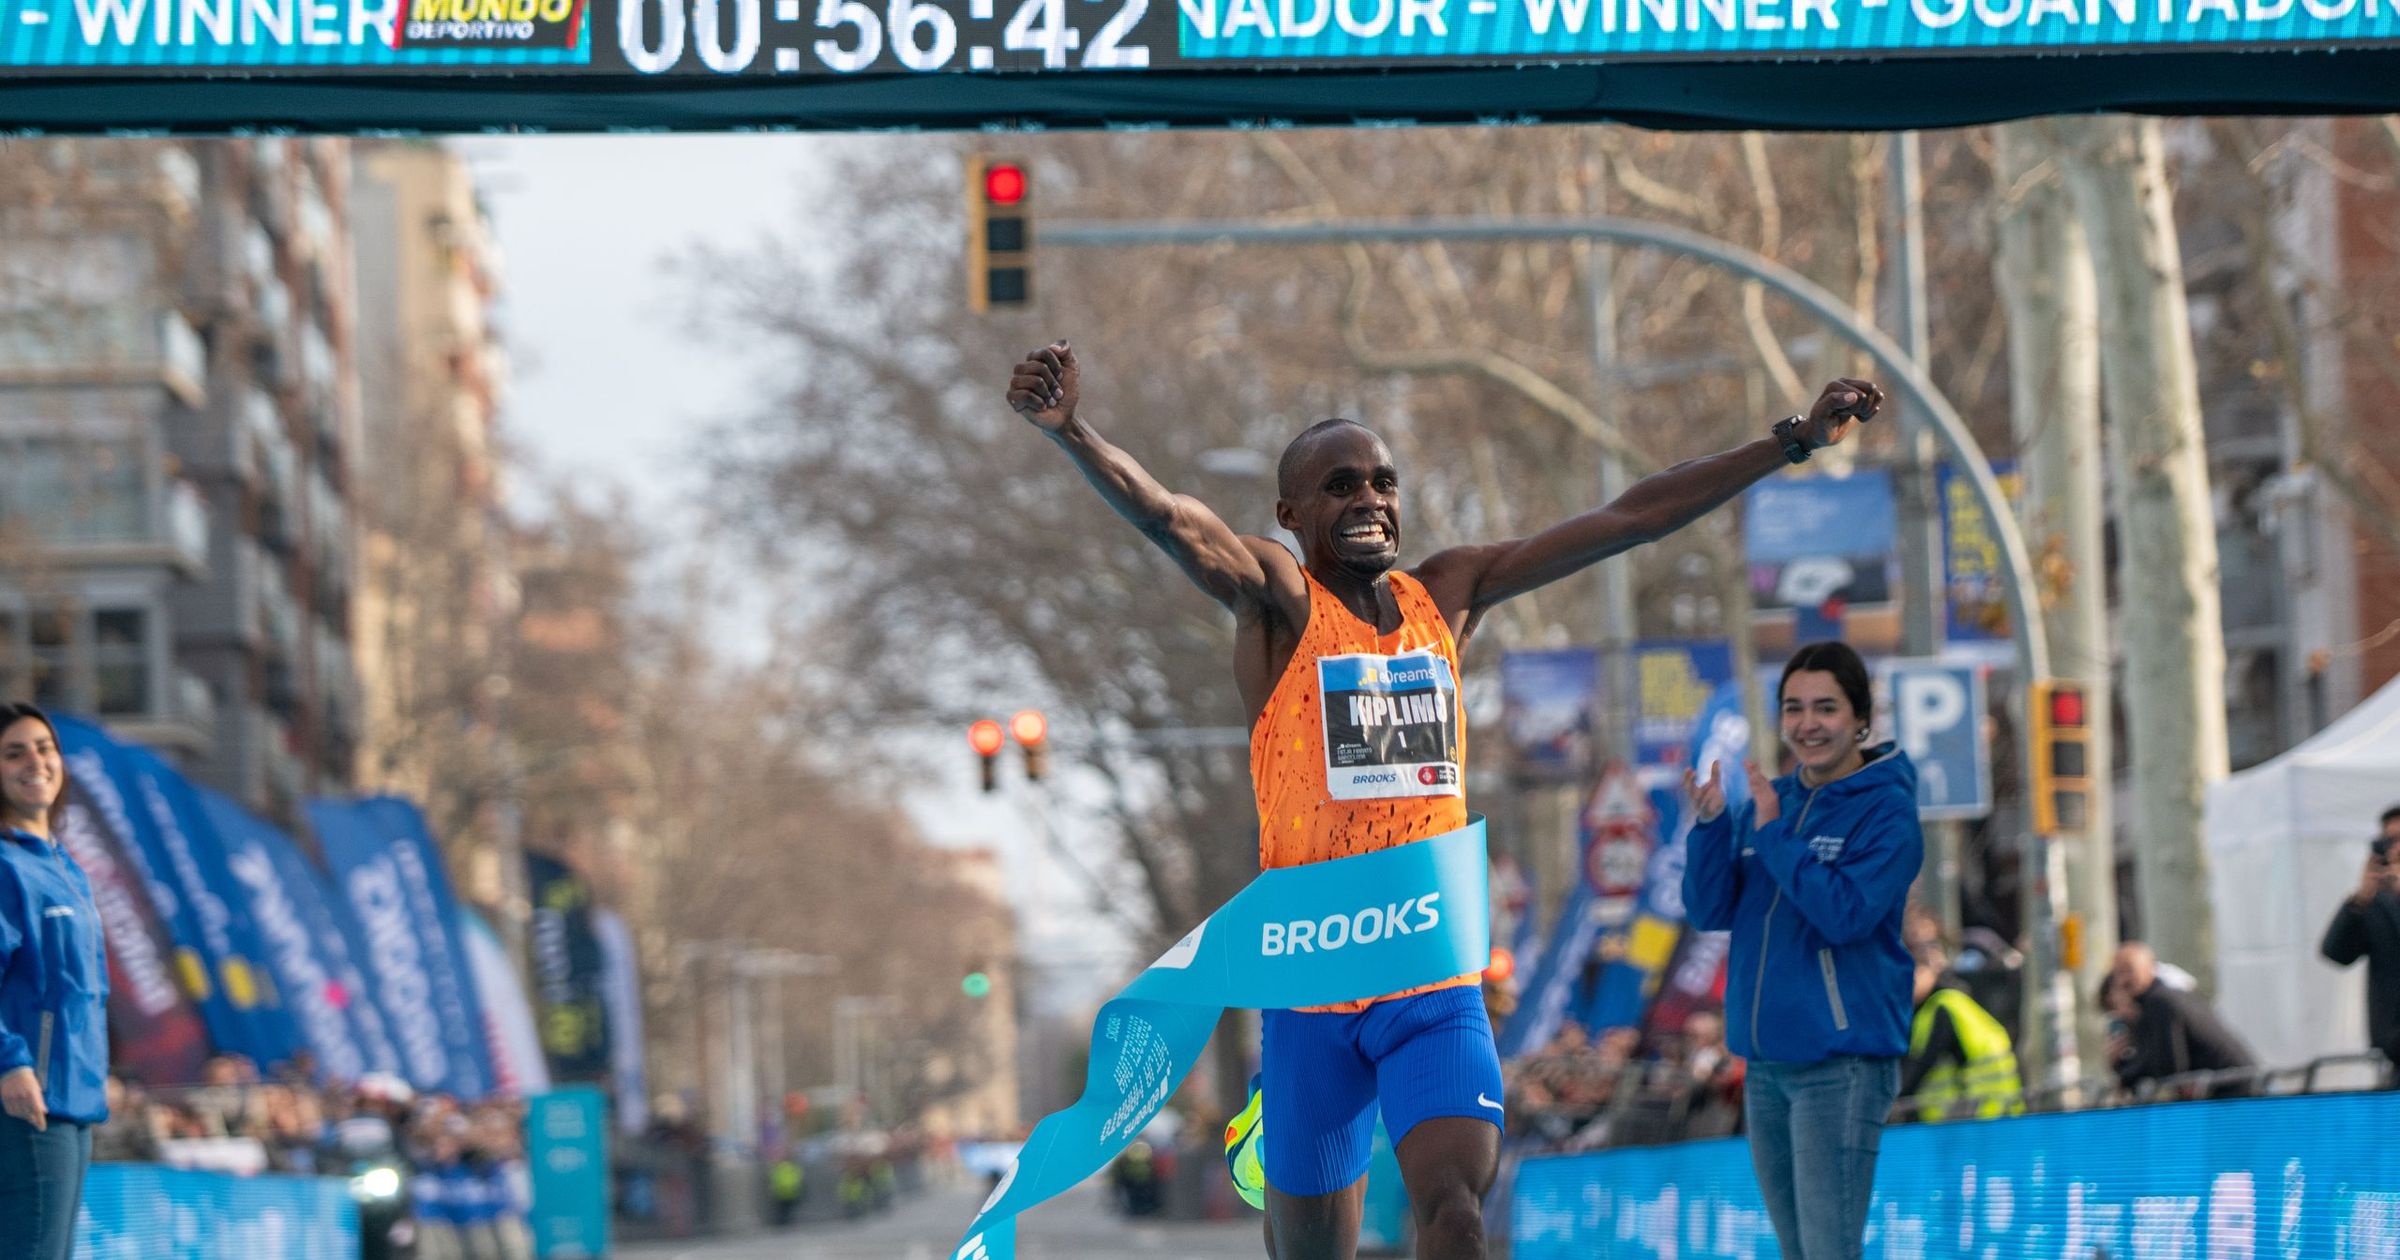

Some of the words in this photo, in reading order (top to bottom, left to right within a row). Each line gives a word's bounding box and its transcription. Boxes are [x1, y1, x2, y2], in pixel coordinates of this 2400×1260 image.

[75, 0, 396, 46] WINNER
[411, 0, 572, 22] MUNDO
[406, 20, 535, 39] DEPORTIVO
[617, 0, 1150, 74] 00:56:42
[1380, 666, 1438, 684] eDreams
[1348, 692, 1448, 726] KIPLIMO
[1352, 773, 1397, 785] BROOKS
[1261, 891, 1441, 956] BROOKS
